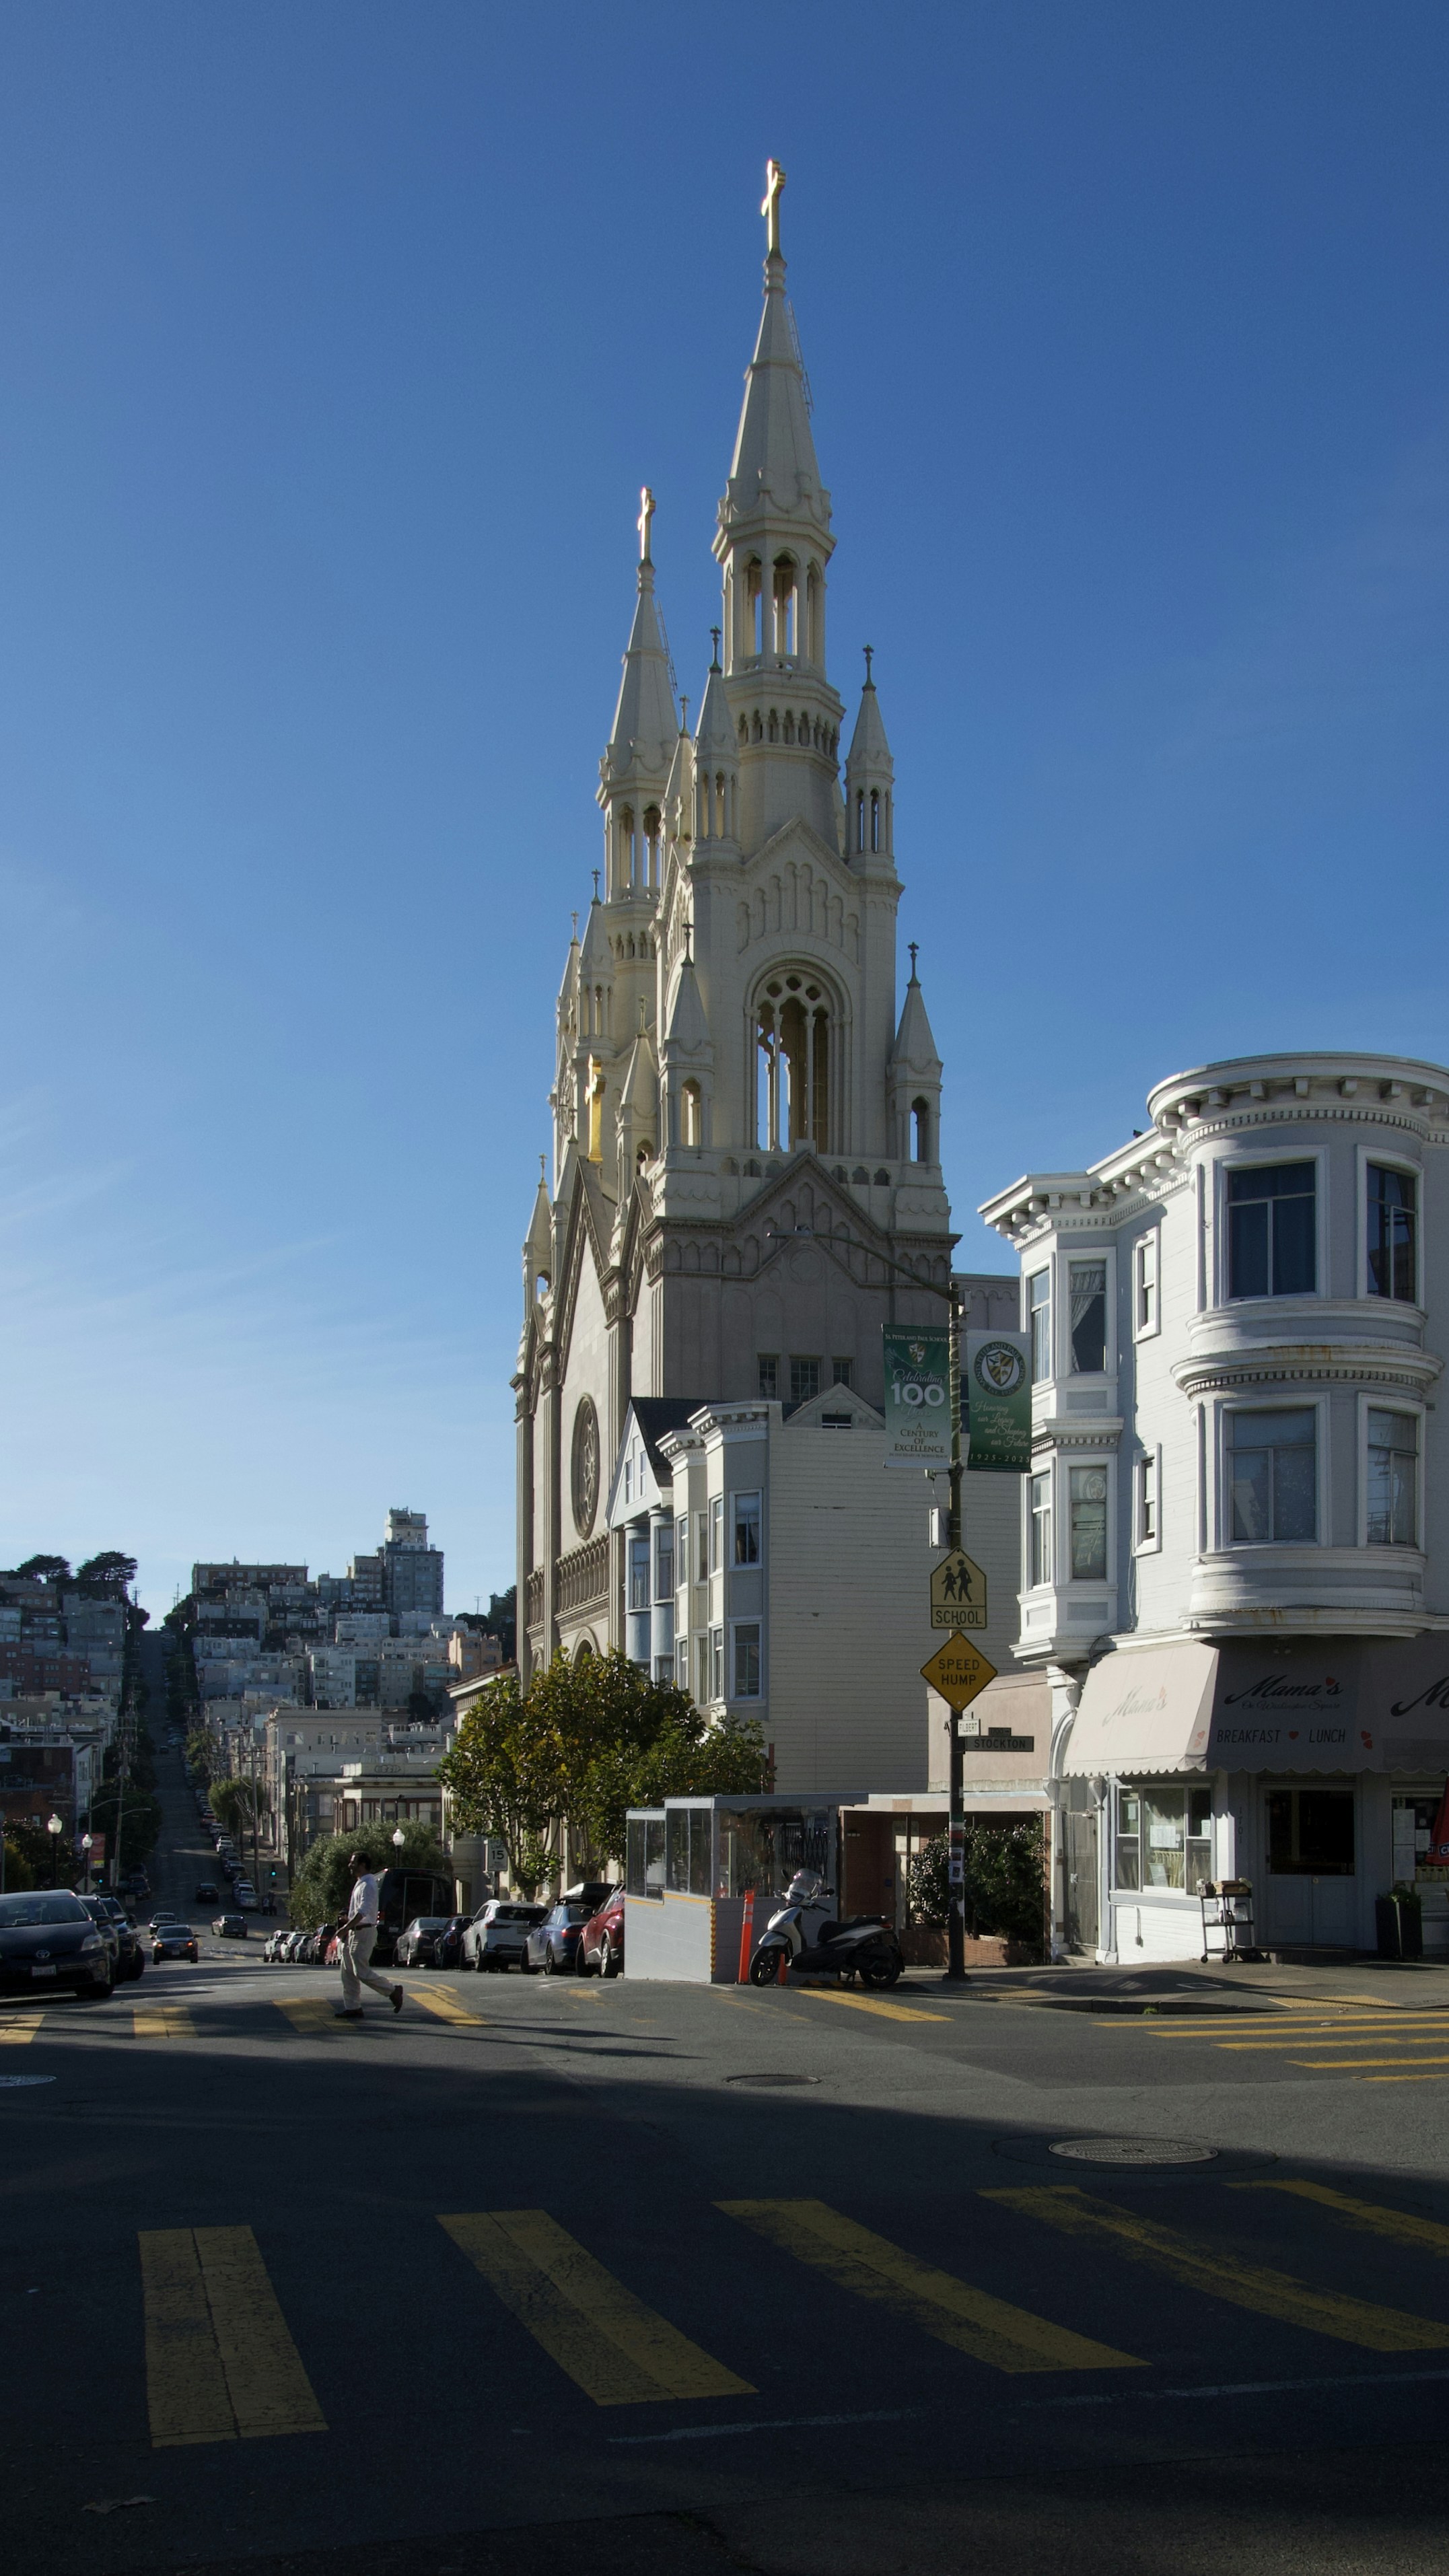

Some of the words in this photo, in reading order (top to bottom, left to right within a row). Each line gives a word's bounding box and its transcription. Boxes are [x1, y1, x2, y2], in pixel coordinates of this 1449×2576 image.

[893, 1368, 943, 1385] Celebrating
[890, 1382, 945, 1406] 100
[970, 1400, 1010, 1415] Honoring
[900, 1429, 939, 1437] CENTURY
[997, 1424, 1027, 1439] Shaping
[1003, 1435, 1029, 1447] Future
[894, 1443, 945, 1453] EXCELLENCE
[935, 1610, 983, 1624] SCHOOL
[938, 1658, 980, 1670] SPEED
[942, 1674, 976, 1686] HUMP
[1224, 1674, 1344, 1705] Mama's
[1102, 1685, 1168, 1727] Mama's
[1257, 1699, 1307, 1711] Washington
[1308, 1699, 1341, 1711] Square
[1217, 1729, 1281, 1744] BREAKFAST
[1309, 1728, 1346, 1743] LUNCH
[975, 1738, 1026, 1749] STOCKTON
[491, 1850, 505, 1860] 15
